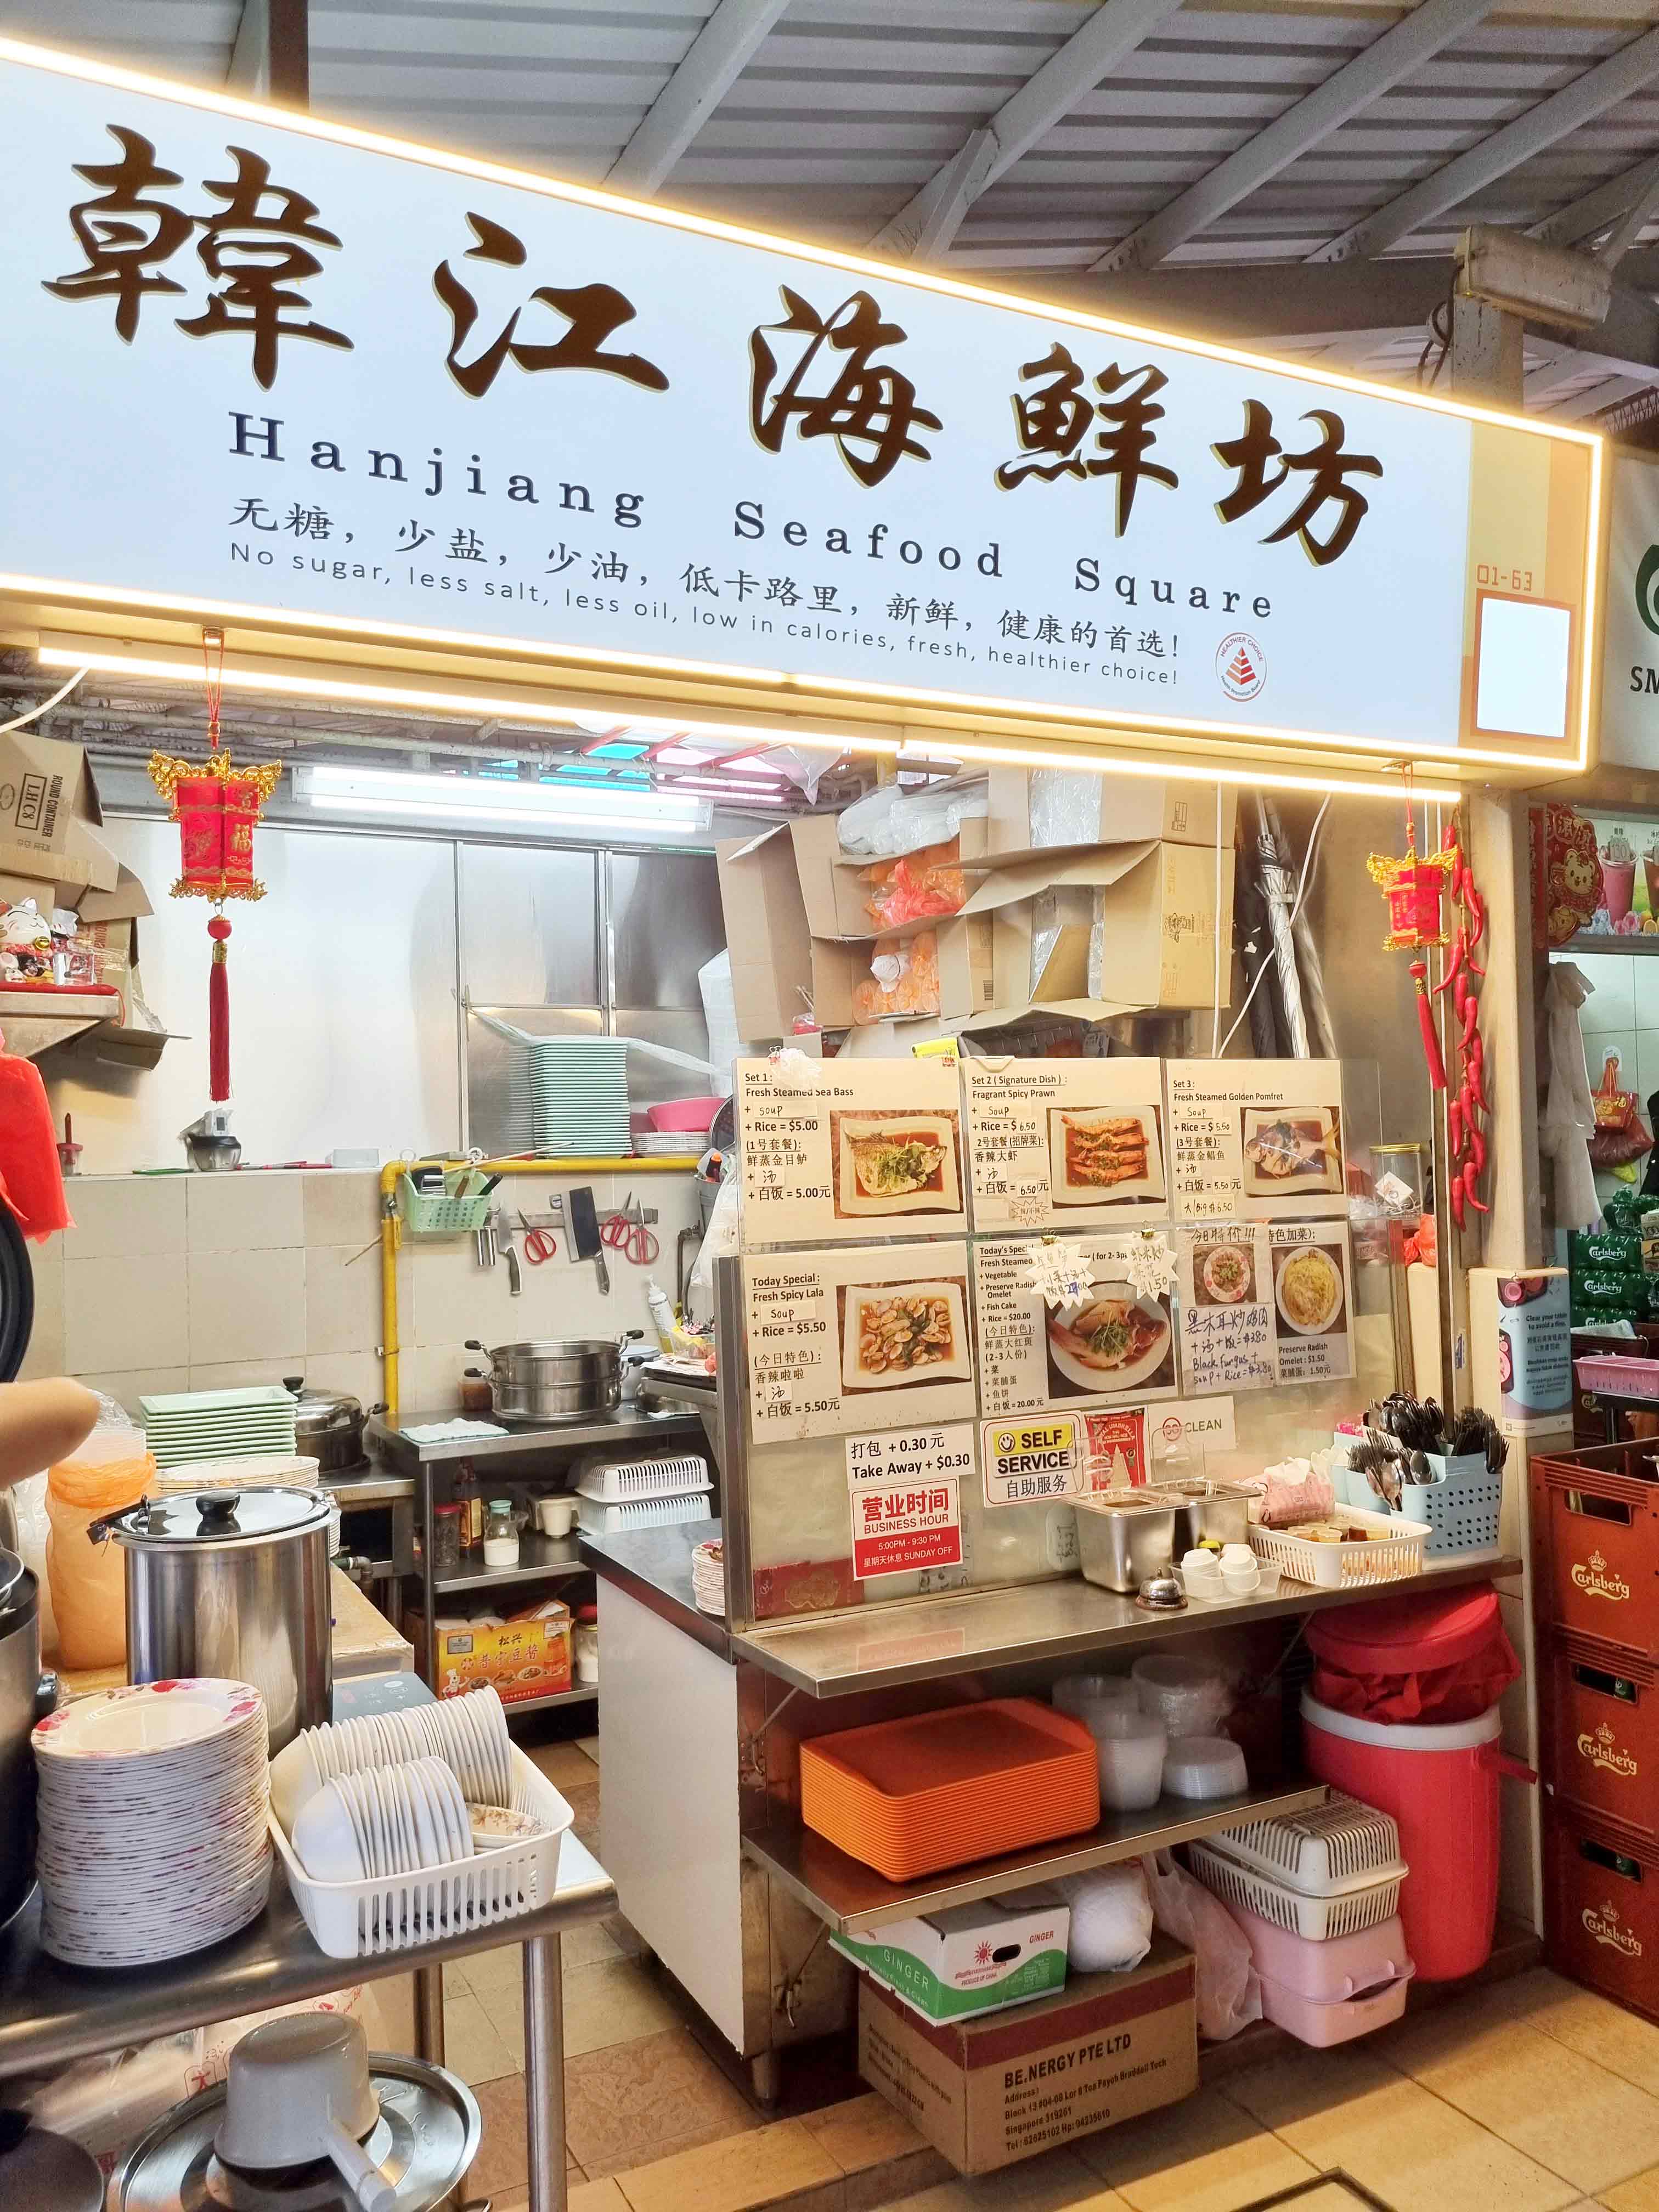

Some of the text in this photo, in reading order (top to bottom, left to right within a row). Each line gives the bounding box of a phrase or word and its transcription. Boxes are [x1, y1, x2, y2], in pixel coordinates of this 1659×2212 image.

[228, 411, 1271, 618] Hanjiang Seafood Square
[1477, 565, 1533, 591] 01-63
[231, 542, 1178, 685] No sugar, less salt, less oil, low in calories, fresh, healthier choice!
[1220, 636, 1264, 662] HEALTHIER CHOICE
[42, 775, 63, 838] ROUND CONTAINER
[972, 1076, 985, 1084] Set
[988, 1076, 991, 1084] 2
[746, 1088, 770, 1096] Fresh
[774, 1088, 812, 1096] Steamed
[973, 1091, 1006, 1100] Fragrant
[1008, 1090, 1028, 1099] Spicy
[1174, 1093, 1193, 1102] Fresh
[1195, 1093, 1227, 1101] Steamed
[1256, 1092, 1283, 1101] Pomfret
[755, 1120, 818, 1132] Rice $5.00
[981, 1121, 1001, 1131] Rice
[1181, 1122, 1198, 1132] Rice
[747, 1154, 807, 1166] 鲜蒸金目鲈
[974, 1150, 1017, 1163] 香辣大虾
[986, 1182, 1007, 1194] 白饭
[1185, 1180, 1204, 1192] 白饭
[759, 1187, 783, 1201] 白饭
[1589, 1246, 1627, 1261] Carlsberg
[752, 1277, 781, 1286] Today
[985, 1271, 1017, 1279] Vegetable
[753, 1288, 823, 1302] Fresh Spicy Lala
[1584, 1280, 1622, 1295] Carlsberg
[1009, 1312, 1031, 1321] $20.00
[762, 1322, 826, 1337] Rice $5.50
[1279, 1343, 1328, 1353] Preserve Radish
[1308, 1355, 1325, 1363] $1.50
[755, 1368, 805, 1384] 香辣啦啦
[768, 1402, 792, 1418] 白饭
[994, 1400, 1010, 1411] 白饭
[1186, 1419, 1222, 1433] CLEAN
[1021, 1429, 1062, 1449] SELF
[851, 1441, 882, 1459] 打包
[853, 1453, 970, 1479] Take Away $0.30
[997, 1451, 1069, 1474] SERVICE
[1007, 1474, 1067, 1498] 自助服务
[862, 1488, 949, 1522] 营业时间
[864, 1514, 949, 1534] BUSINESS HOUR
[878, 1534, 940, 1550] 5:00PM 9:30 PM
[864, 1546, 953, 1567] 星期天休息 SUNDAY OFF
[1571, 1564, 1629, 1600] Carlsberg
[1577, 1734, 1637, 1775] Carlsberg
[1029, 1931, 1054, 1944] GINGER
[1582, 1909, 1641, 1956] Carlsberg
[884, 1949, 929, 1991] GINGER
[1005, 2033, 1131, 2089] BE.NERGY PTE LTD
[1005, 2107, 1026, 2120] Block
